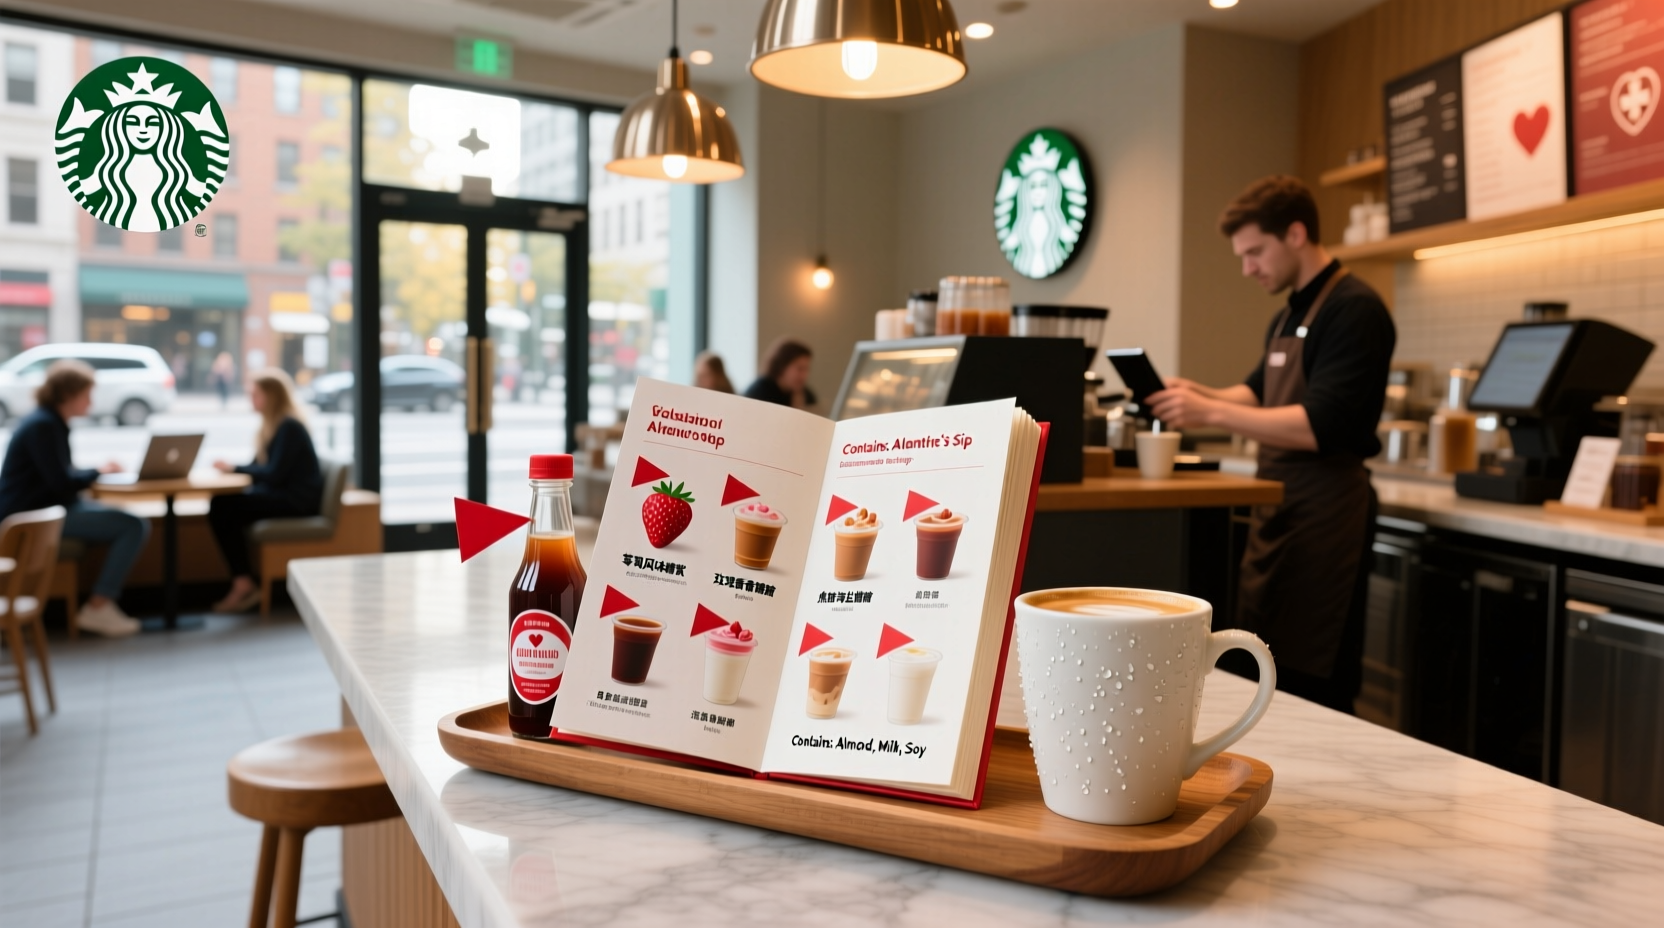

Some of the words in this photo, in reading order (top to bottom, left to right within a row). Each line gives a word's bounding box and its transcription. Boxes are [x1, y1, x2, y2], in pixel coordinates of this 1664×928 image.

[952, 433, 973, 450] Sip
[878, 740, 902, 756] Milk,
[904, 741, 927, 759] Soy
